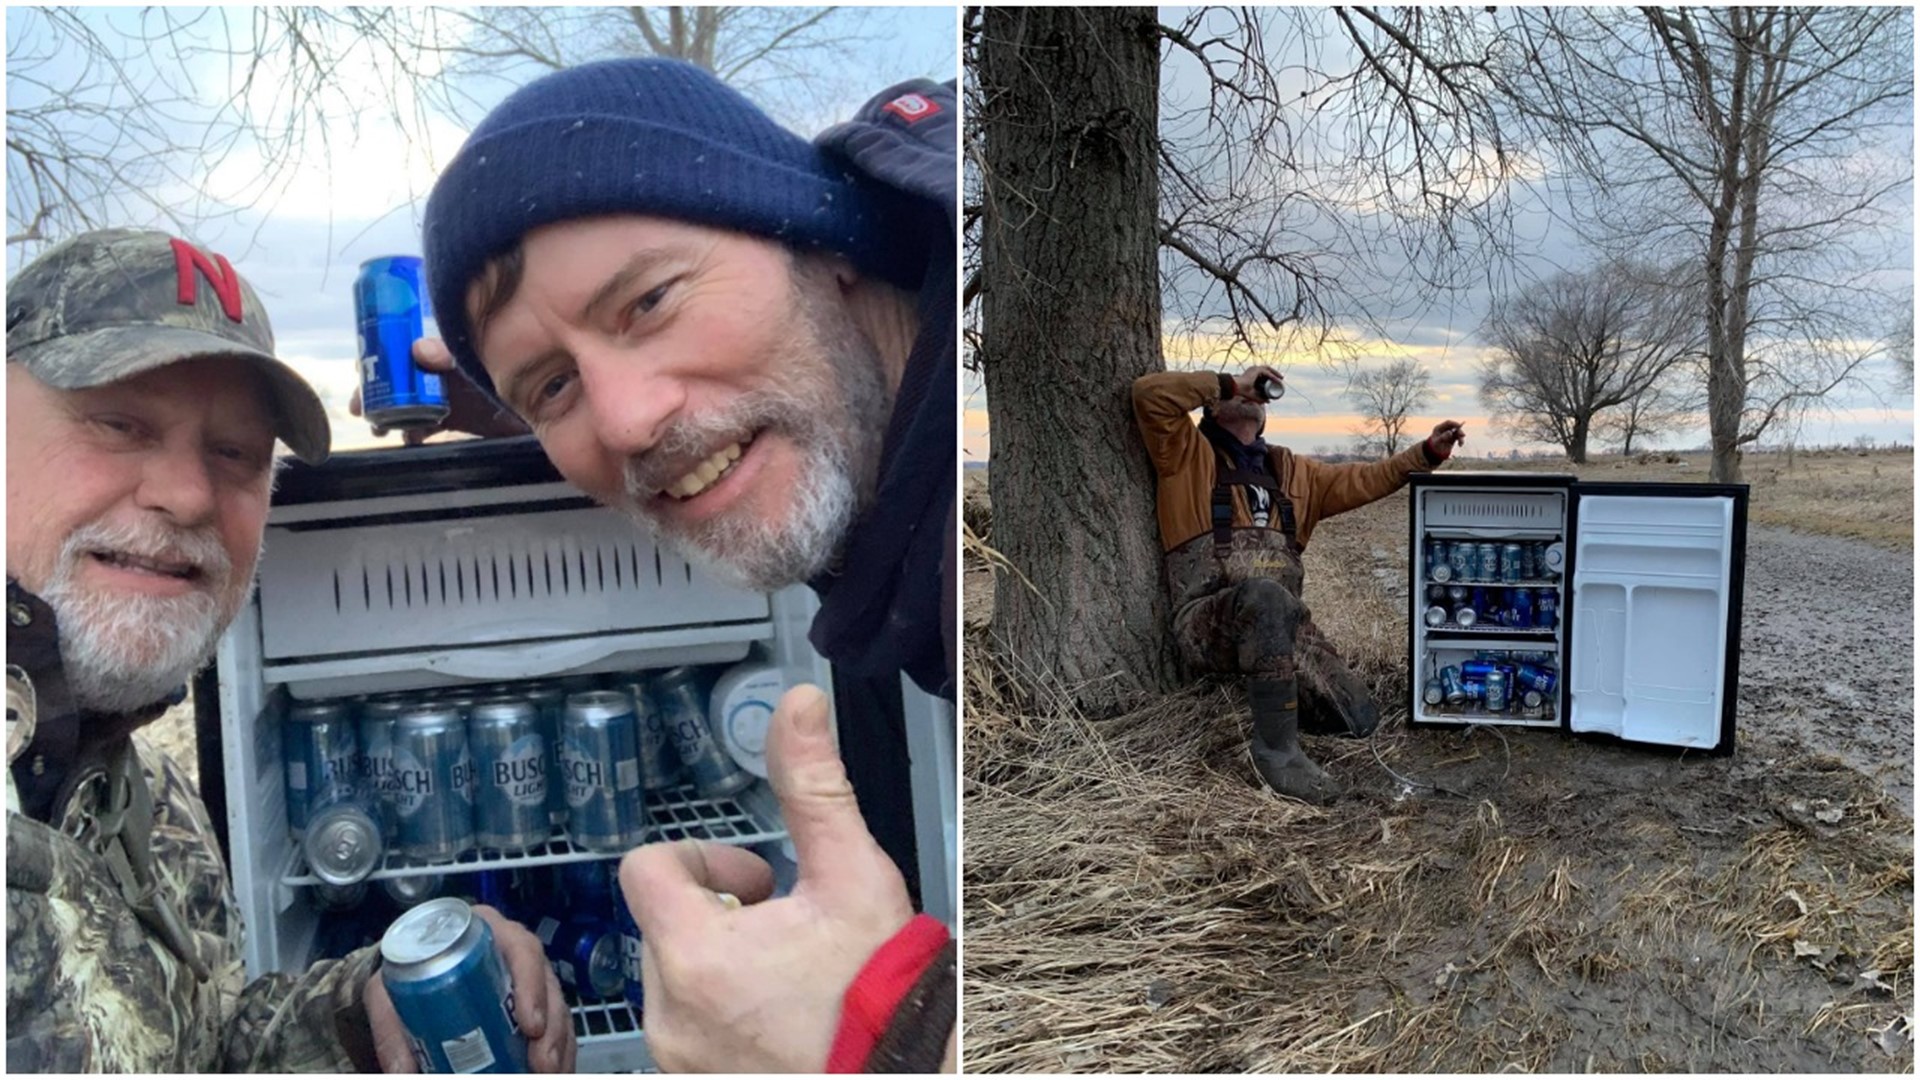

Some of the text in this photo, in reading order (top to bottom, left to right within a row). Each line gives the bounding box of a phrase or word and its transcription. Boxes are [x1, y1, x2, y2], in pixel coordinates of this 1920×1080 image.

[169, 236, 243, 324] N
[363, 756, 394, 778] BUS
[495, 754, 547, 785] BUSC
[563, 758, 601, 786] SCH
[394, 768, 430, 794] SCH
[514, 778, 544, 797] LIGH
